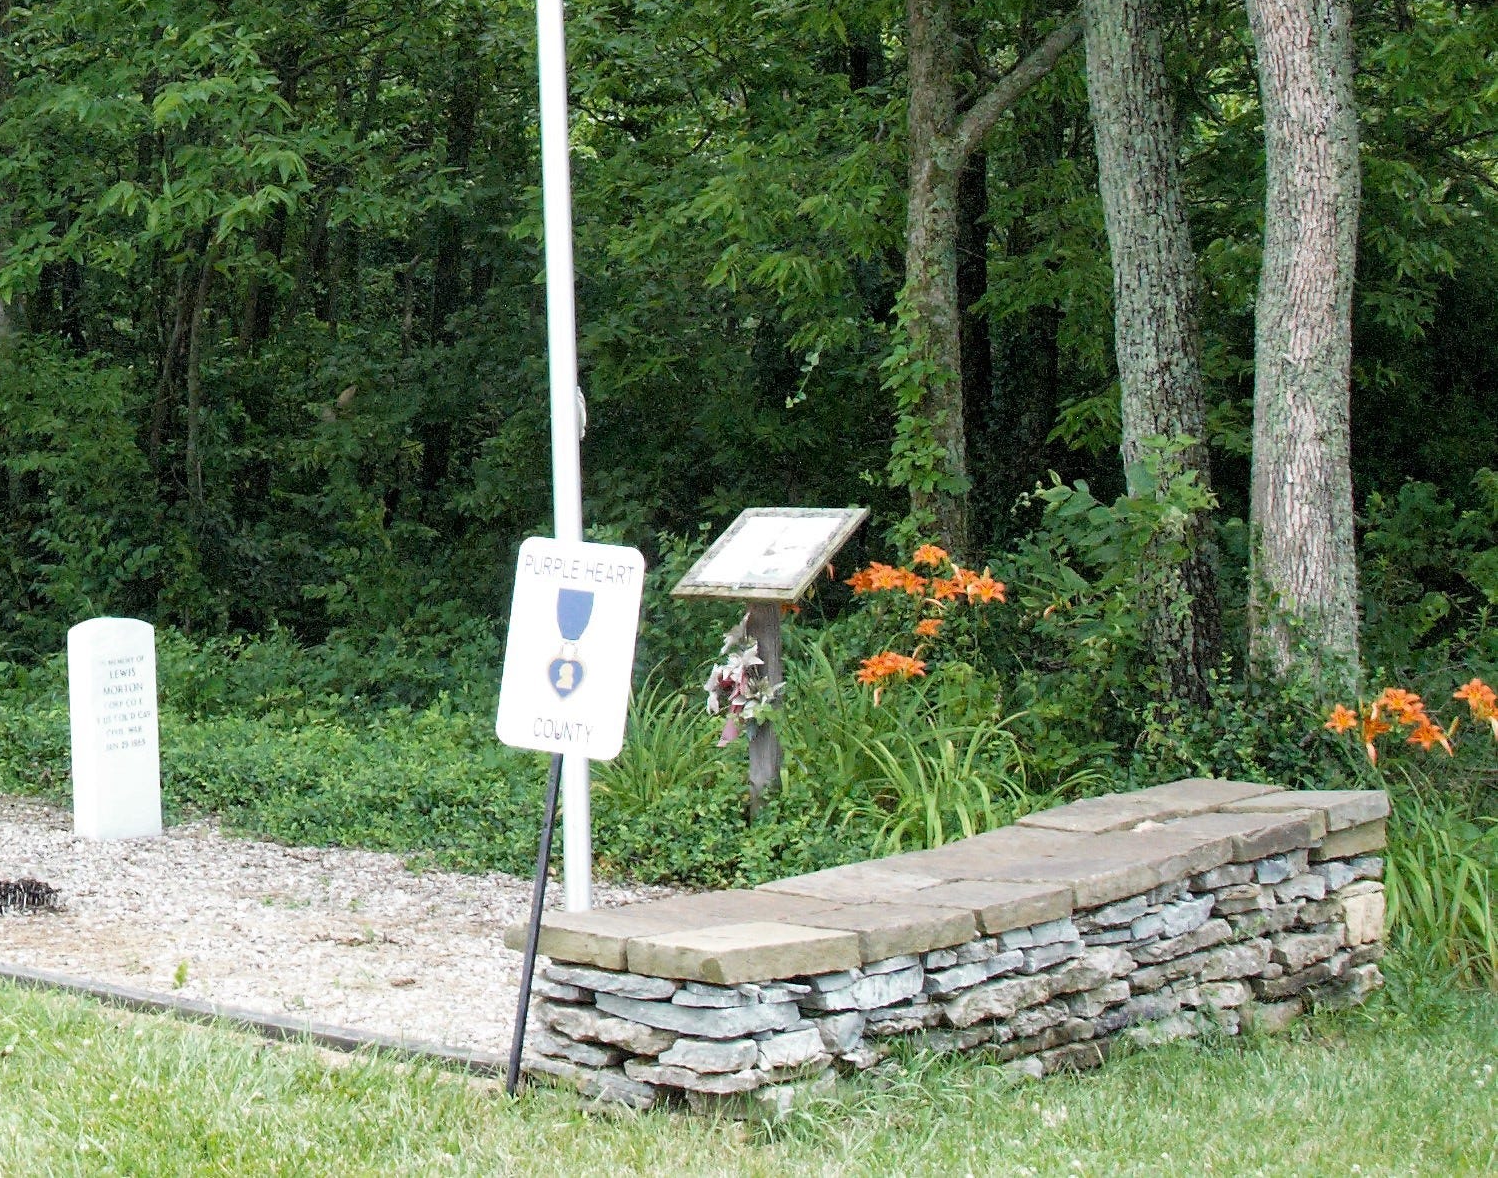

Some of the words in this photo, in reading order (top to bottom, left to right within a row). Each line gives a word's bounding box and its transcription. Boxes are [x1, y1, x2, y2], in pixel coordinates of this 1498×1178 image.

[525, 555, 579, 581] PURPLE
[585, 561, 634, 586] HEART
[110, 668, 135, 679] LEWIS
[103, 683, 142, 694] MORTON
[534, 717, 594, 742] COUNTY
